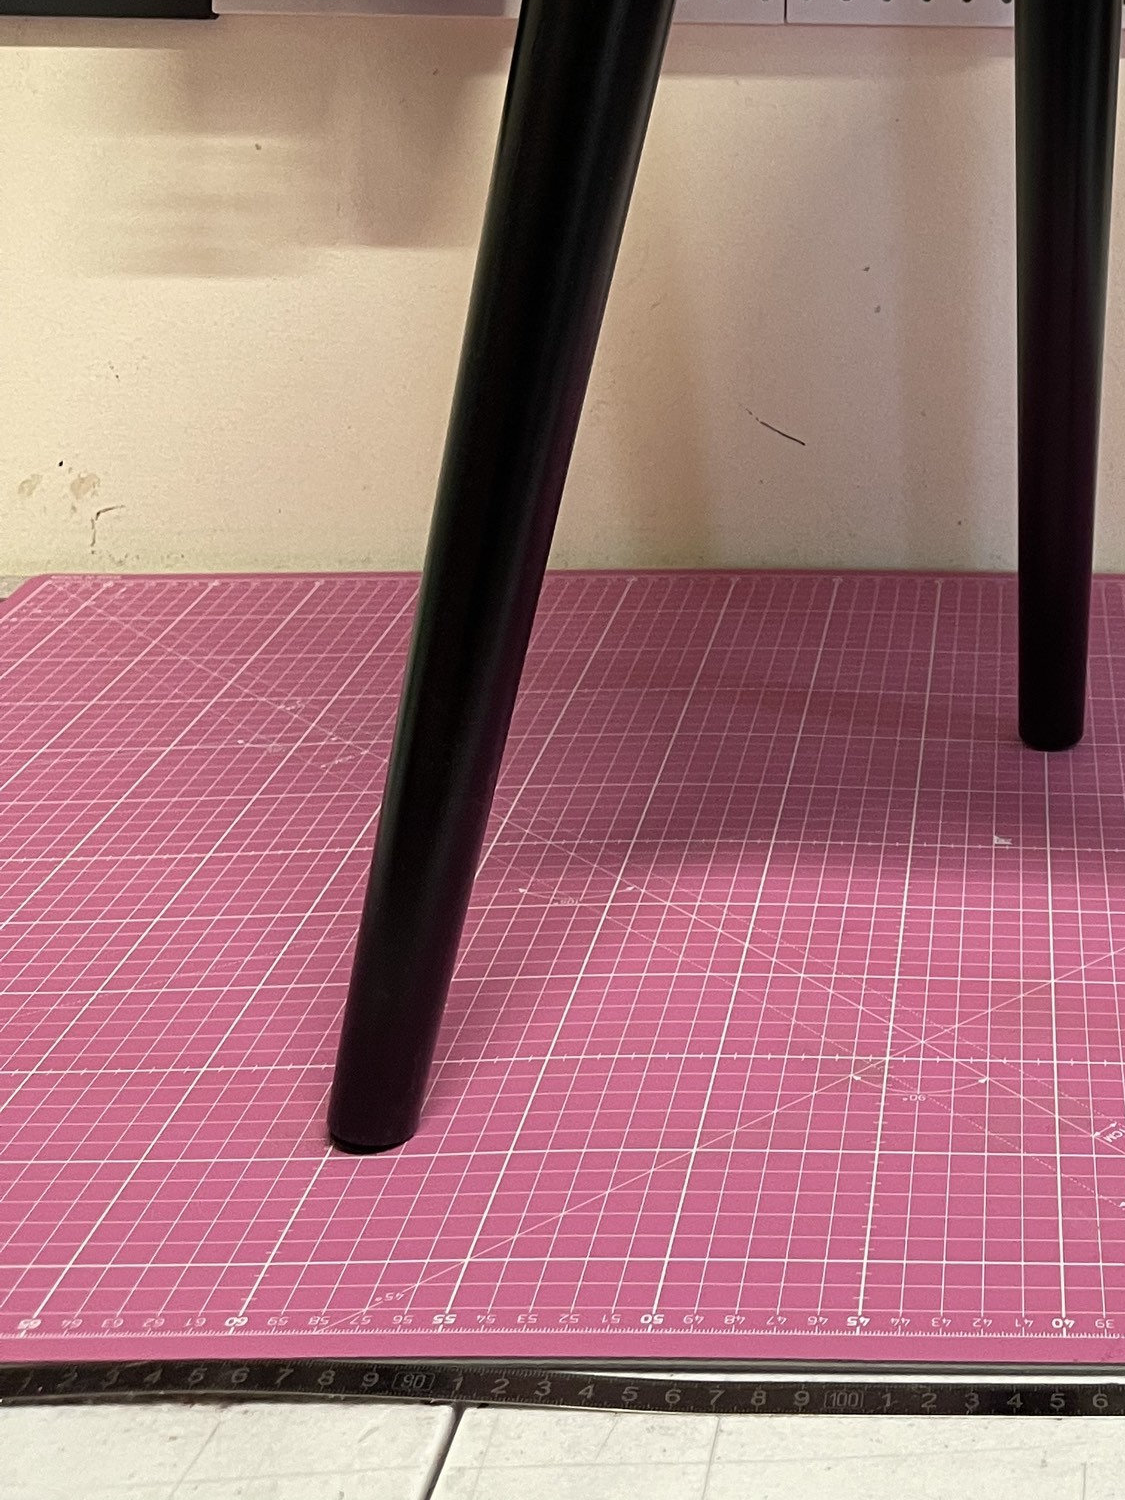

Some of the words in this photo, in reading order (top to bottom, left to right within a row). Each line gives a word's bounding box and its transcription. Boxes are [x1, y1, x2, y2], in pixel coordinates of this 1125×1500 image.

[18, 1318, 41, 1329] 65
[62, 1318, 83, 1329] 64
[102, 1318, 123, 1329] 63
[143, 1317, 165, 1328] 62
[185, 1317, 206, 1328] 61
[225, 1316, 249, 1327] 60
[267, 1316, 288, 1326] 59
[308, 1316, 330, 1326] 58
[350, 1315, 371, 1325] 57
[392, 1315, 412, 1325] 56
[433, 1314, 457, 1325] 55
[477, 1314, 496, 1324] 54
[517, 1314, 537, 1324] 53
[560, 1314, 580, 1324] 52
[602, 1314, 621, 1324] 51
[641, 1313, 664, 1324] 50
[684, 1314, 704, 1324] 49
[725, 1314, 745, 1324] 48
[767, 1315, 786, 1325] 47
[808, 1316, 827, 1325] 46
[847, 1316, 870, 1327] 45
[890, 1317, 910, 1327] 44
[932, 1318, 951, 1328] 43
[973, 1318, 992, 1328] 42
[1015, 1318, 1033, 1329] 41
[1052, 1318, 1075, 1329] 40
[1095, 1319, 1114, 1329] 39
[188, 1369, 205, 1383] 5
[231, 1368, 249, 1383] 6
[276, 1369, 293, 1383] 7
[318, 1370, 335, 1385] 8
[361, 1372, 379, 1388] 9
[402, 1375, 426, 1388] 90
[452, 1377, 463, 1391] 1
[490, 1379, 508, 1394] 2
[534, 1381, 552, 1396] 3
[577, 1384, 595, 1398] 4
[621, 1387, 639, 1401] 5
[665, 1389, 682, 1404] 6
[709, 1390, 725, 1405] 7
[751, 1391, 768, 1406] 8
[794, 1391, 810, 1406] 9
[831, 1392, 857, 1407] 100
[881, 1393, 892, 1407] 1
[920, 1393, 937, 1408] 2
[964, 1393, 981, 1408] 3
[1007, 1393, 1023, 1408] 4
[1050, 1394, 1066, 1408] 5
[1092, 1394, 1108, 1408] 6
